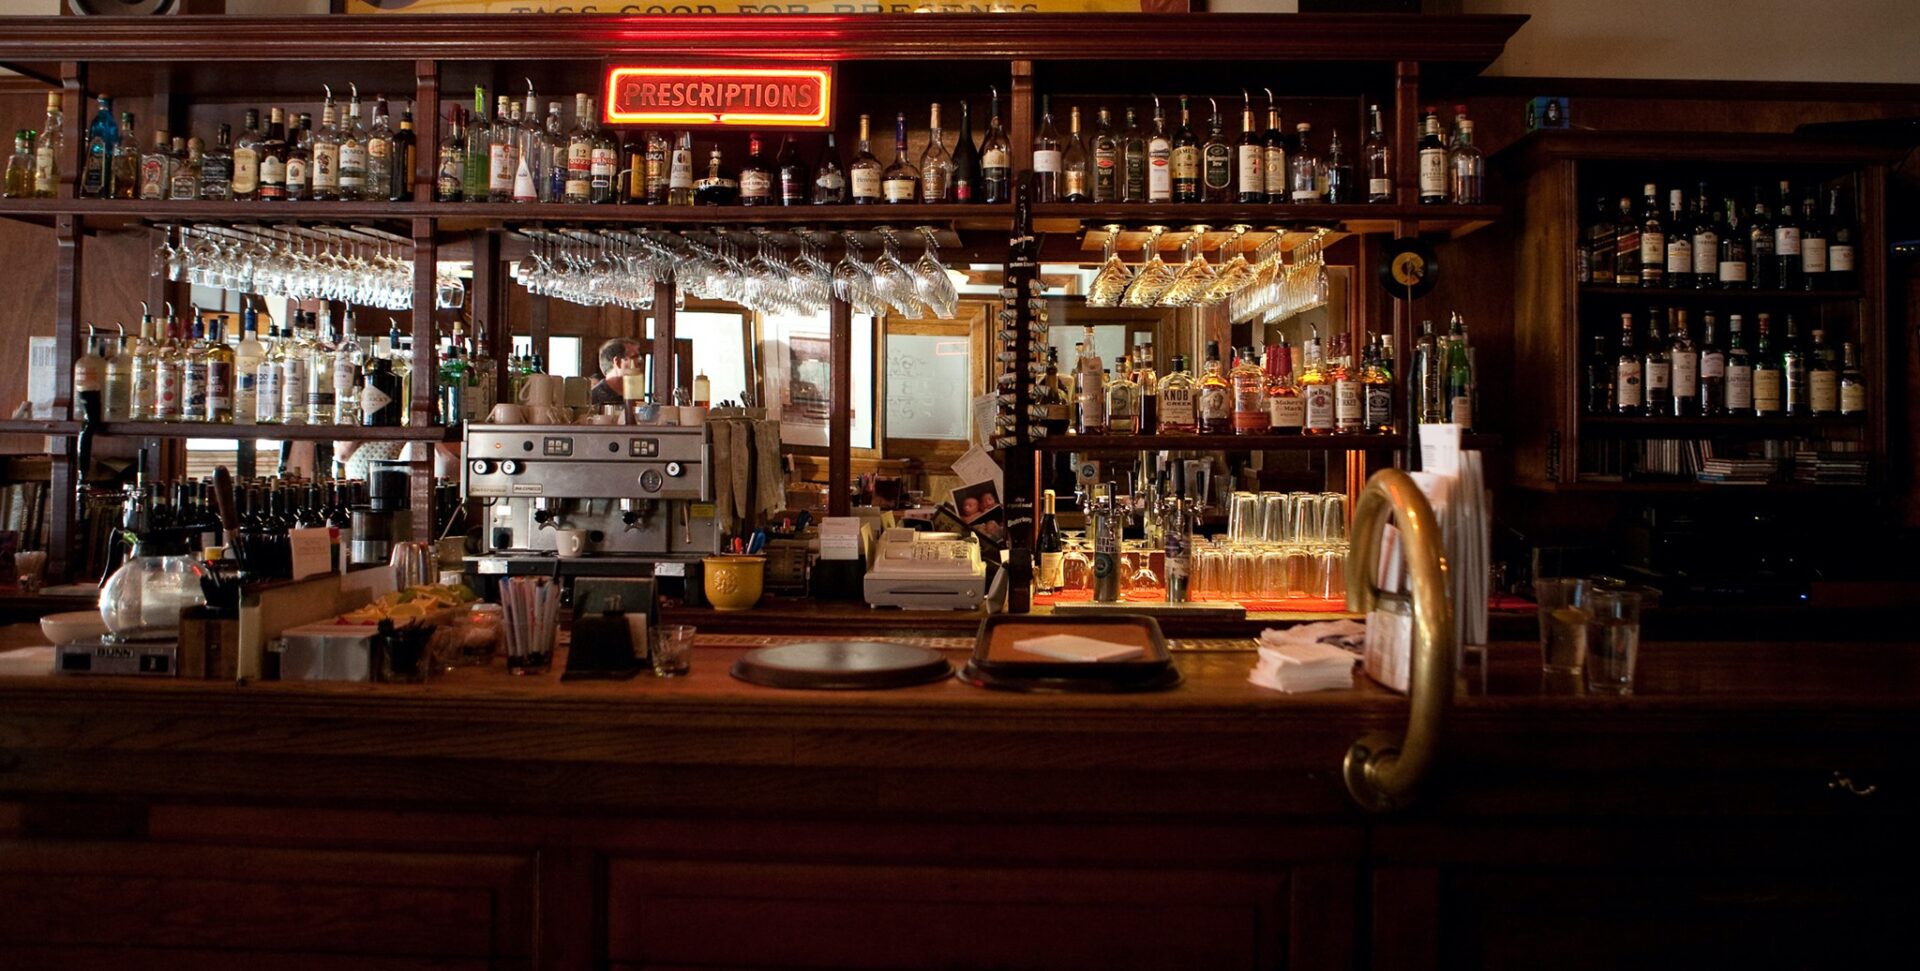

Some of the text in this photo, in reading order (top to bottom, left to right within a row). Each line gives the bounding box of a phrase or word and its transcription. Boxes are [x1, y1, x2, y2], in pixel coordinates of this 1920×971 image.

[623, 81, 813, 108] PRESCRIPTIONS
[1164, 389, 1189, 401] KNOB
[96, 647, 134, 658] BUNN
